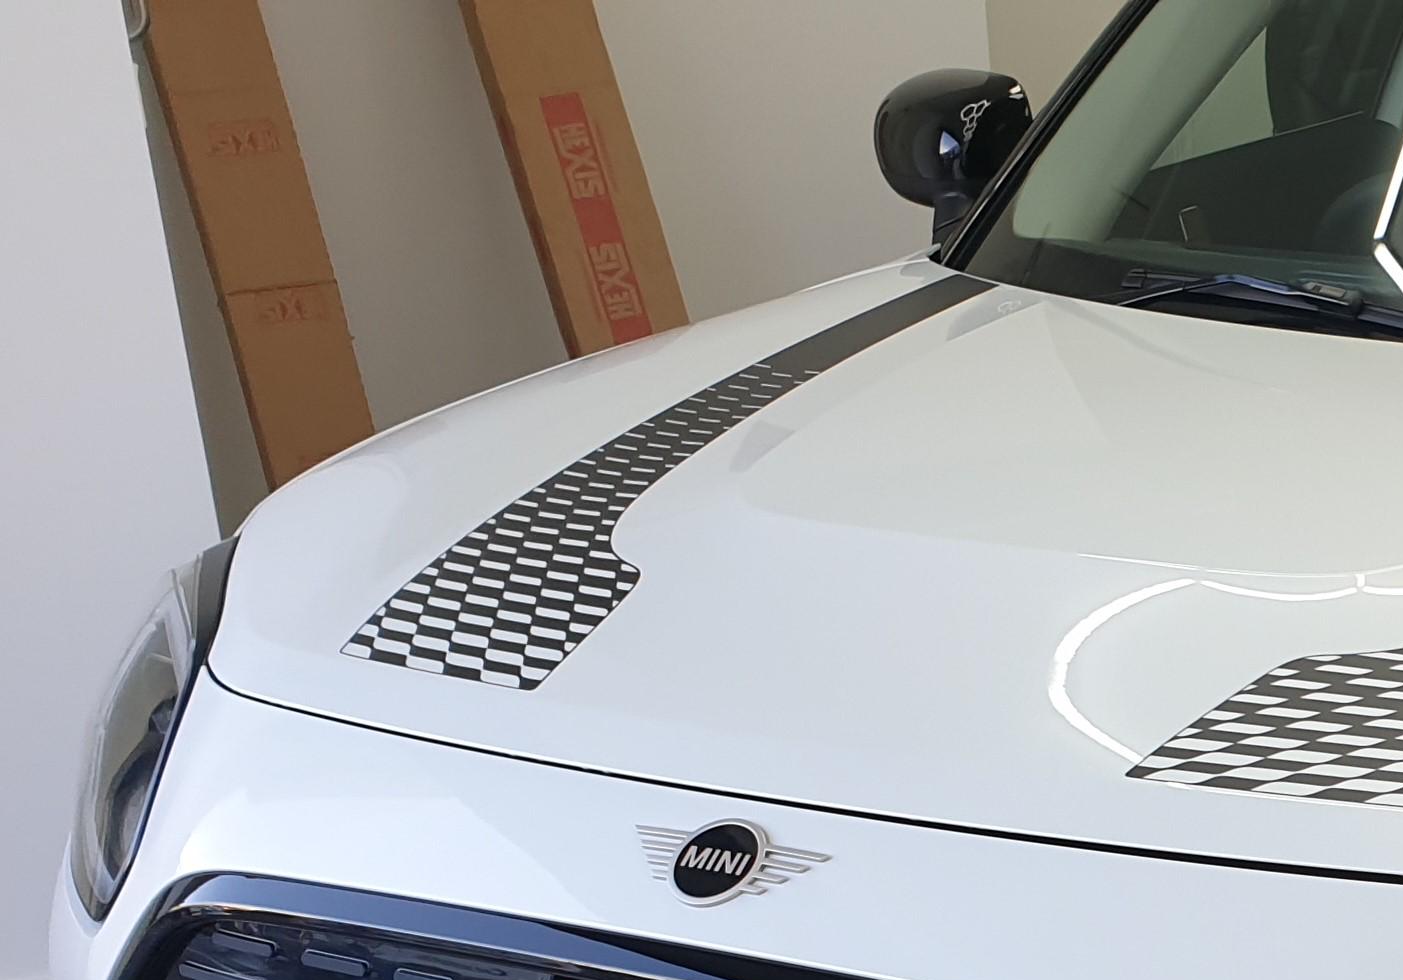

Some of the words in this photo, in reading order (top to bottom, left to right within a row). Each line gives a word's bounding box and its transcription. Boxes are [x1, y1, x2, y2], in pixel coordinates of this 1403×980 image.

[551, 121, 606, 199] HEXIS
[590, 241, 640, 320] HEXIS
[680, 845, 752, 877] MINI
